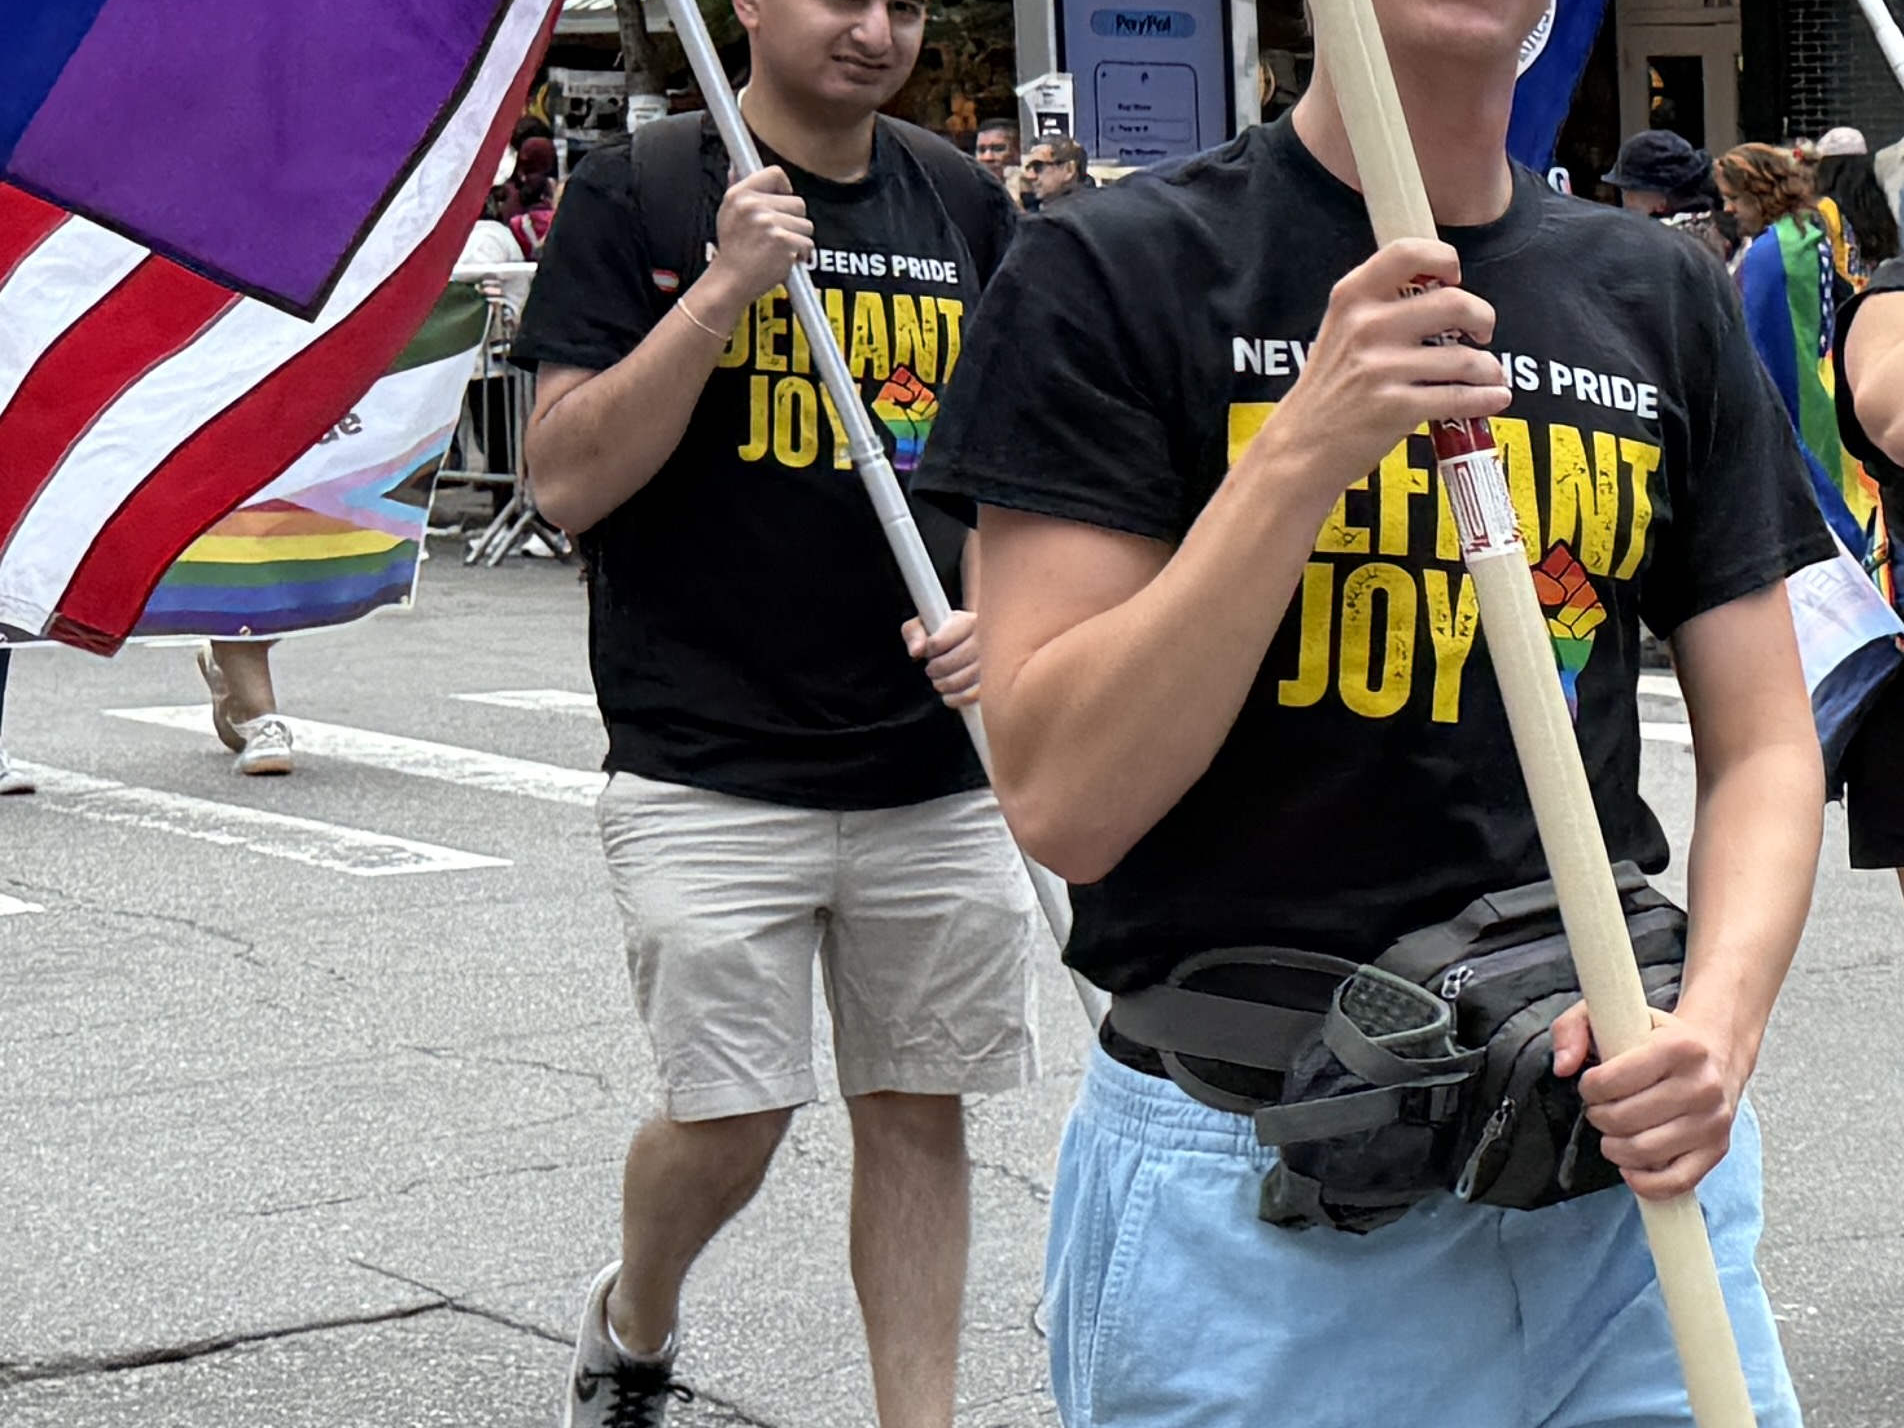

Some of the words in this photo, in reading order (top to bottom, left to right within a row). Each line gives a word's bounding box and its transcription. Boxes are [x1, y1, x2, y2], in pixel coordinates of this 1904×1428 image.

[1116, 13, 1171, 35] PayPal
[806, 248, 888, 278] UEENS
[892, 253, 959, 284] PRIDE
[1550, 359, 1659, 420] PRIDE
[738, 374, 864, 470] JOY
[1277, 561, 1482, 723] JOY
